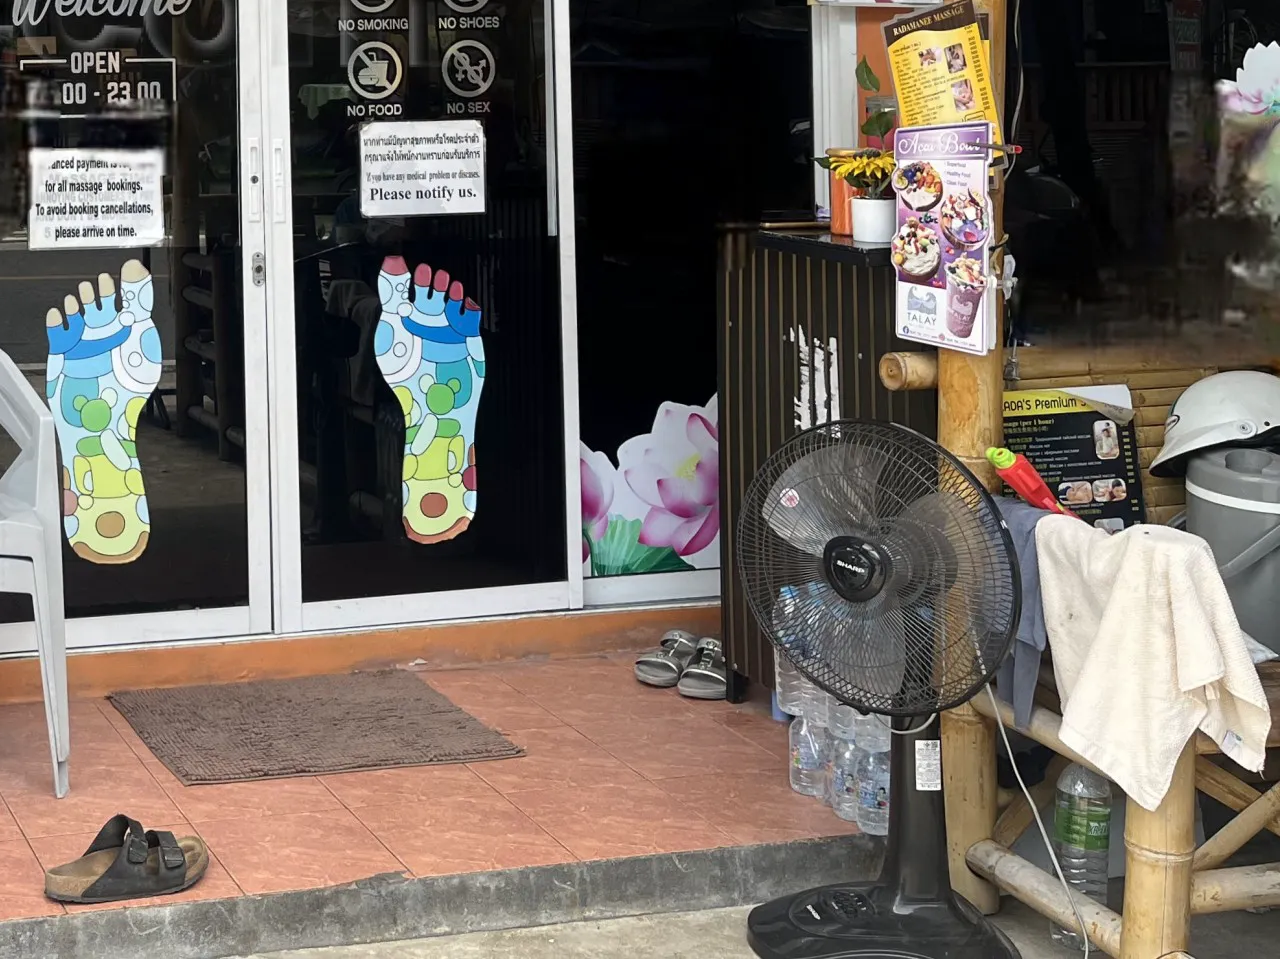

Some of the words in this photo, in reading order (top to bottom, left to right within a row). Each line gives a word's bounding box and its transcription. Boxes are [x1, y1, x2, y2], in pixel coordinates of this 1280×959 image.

[338, 19, 355, 31] NO
[357, 18, 409, 31] SMOKING
[438, 17, 457, 29] NO
[459, 16, 500, 29] SHOES
[892, 15, 933, 37] RADAMANEE
[933, 6, 965, 22] MASSAGE
[70, 51, 121, 74] OPEN
[106, 81, 161, 105] 2300
[347, 104, 366, 117] NO
[368, 104, 403, 116] FOOD
[446, 102, 465, 115] NO
[467, 101, 491, 114] SEX
[382, 172, 395, 181] have
[406, 171, 427, 180] medical
[429, 170, 451, 182] problem
[45, 180, 56, 193] for
[57, 180, 67, 192] all
[69, 182, 103, 195] massage
[106, 179, 143, 194] bookings.
[369, 187, 412, 201] Please
[416, 185, 454, 202] notify
[458, 187, 477, 198] us.
[35, 203, 45, 216] To
[46, 202, 67, 216] avoid
[69, 202, 98, 217] booking
[100, 201, 154, 217] cancellations,
[55, 225, 80, 241] please
[82, 225, 104, 237] arrive
[106, 228, 115, 237] on
[117, 224, 137, 237] time.
[907, 312, 937, 326] TALAY
[1003, 398, 1032, 411] ADA'S
[1034, 396, 1077, 410] Premium
[836, 559, 865, 574] SHARP
